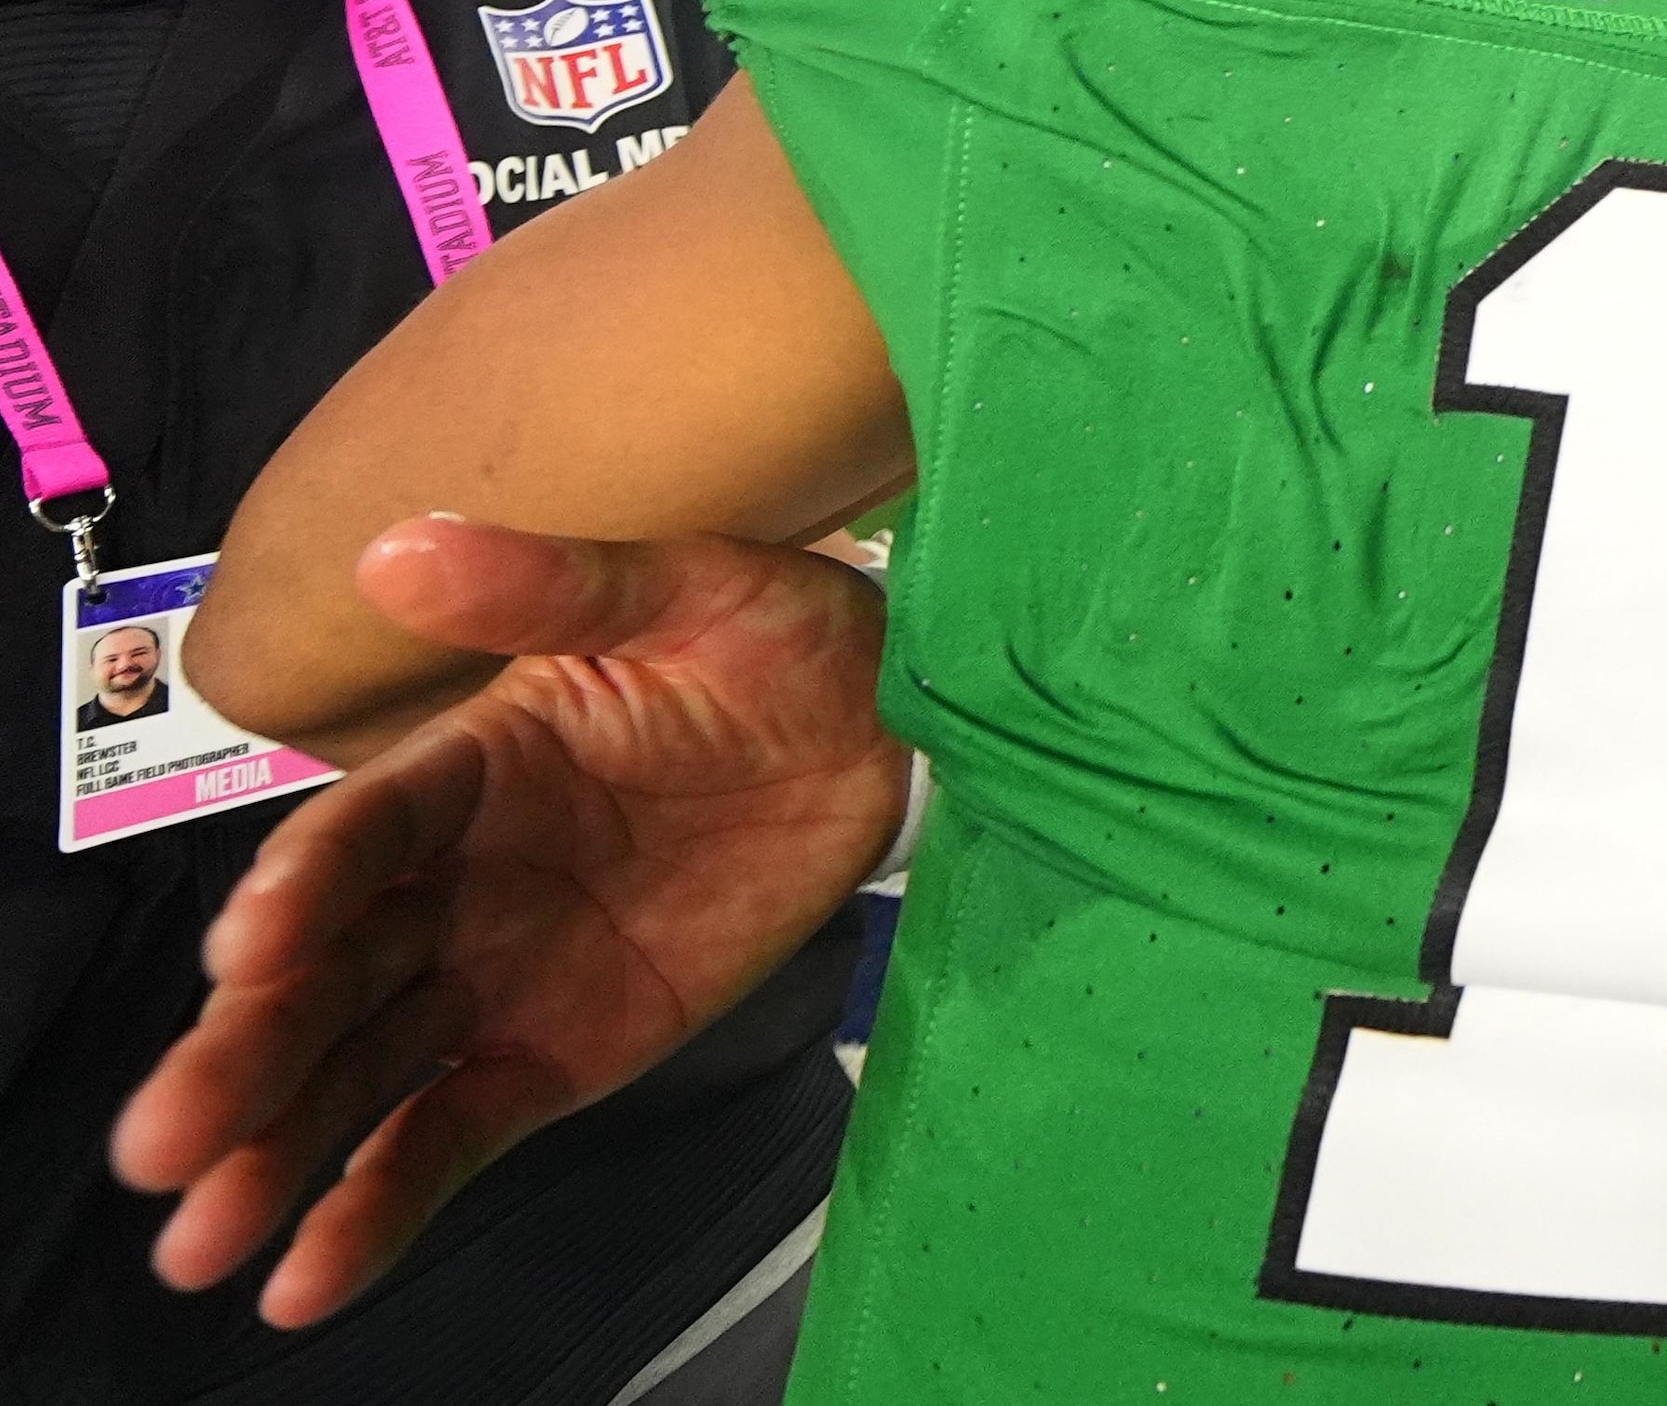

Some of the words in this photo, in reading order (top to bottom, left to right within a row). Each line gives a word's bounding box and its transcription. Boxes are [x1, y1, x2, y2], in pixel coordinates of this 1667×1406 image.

[358, 4, 416, 69] AT&T
[513, 42, 649, 110] NFL
[469, 148, 610, 206] OCIAL
[404, 149, 481, 278] TADIUM
[76, 780, 102, 797] FULL
[104, 774, 135, 791] GAME
[136, 765, 165, 783] FIELD
[167, 743, 250, 775] PHOTOGRAPHER
[77, 741, 137, 766] BREWSTER
[194, 757, 273, 805] MEDIA
